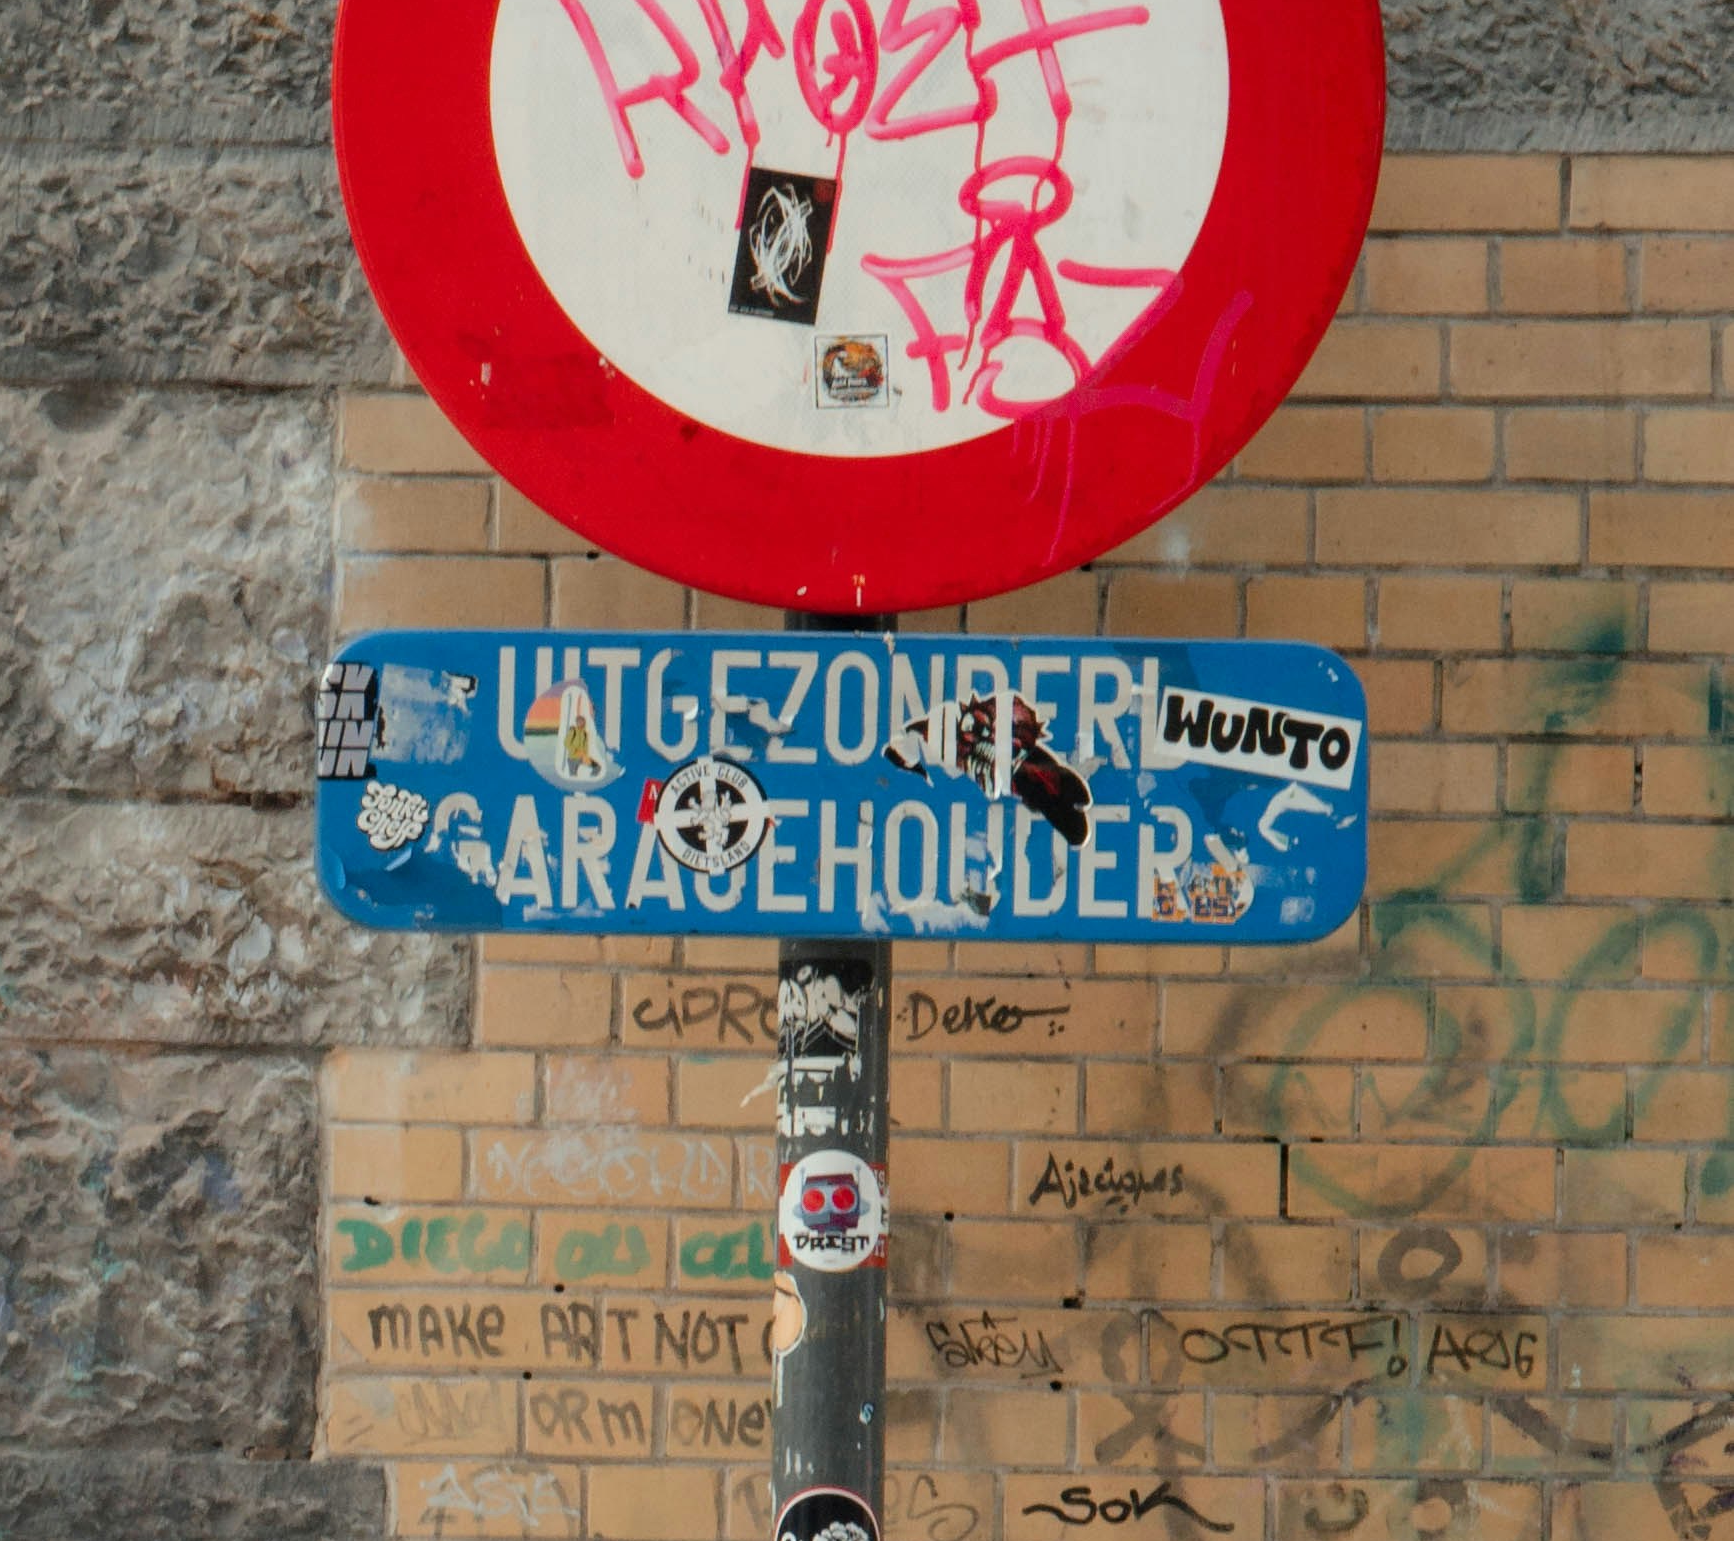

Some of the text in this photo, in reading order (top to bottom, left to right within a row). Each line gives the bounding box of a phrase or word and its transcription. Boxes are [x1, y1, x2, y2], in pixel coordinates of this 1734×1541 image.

[1163, 665, 1351, 770] WUNTO
[670, 764, 711, 794] ACTIVE
[717, 765, 749, 789] CLUB
[540, 1301, 640, 1366] ART
[654, 1310, 749, 1375] NOT
